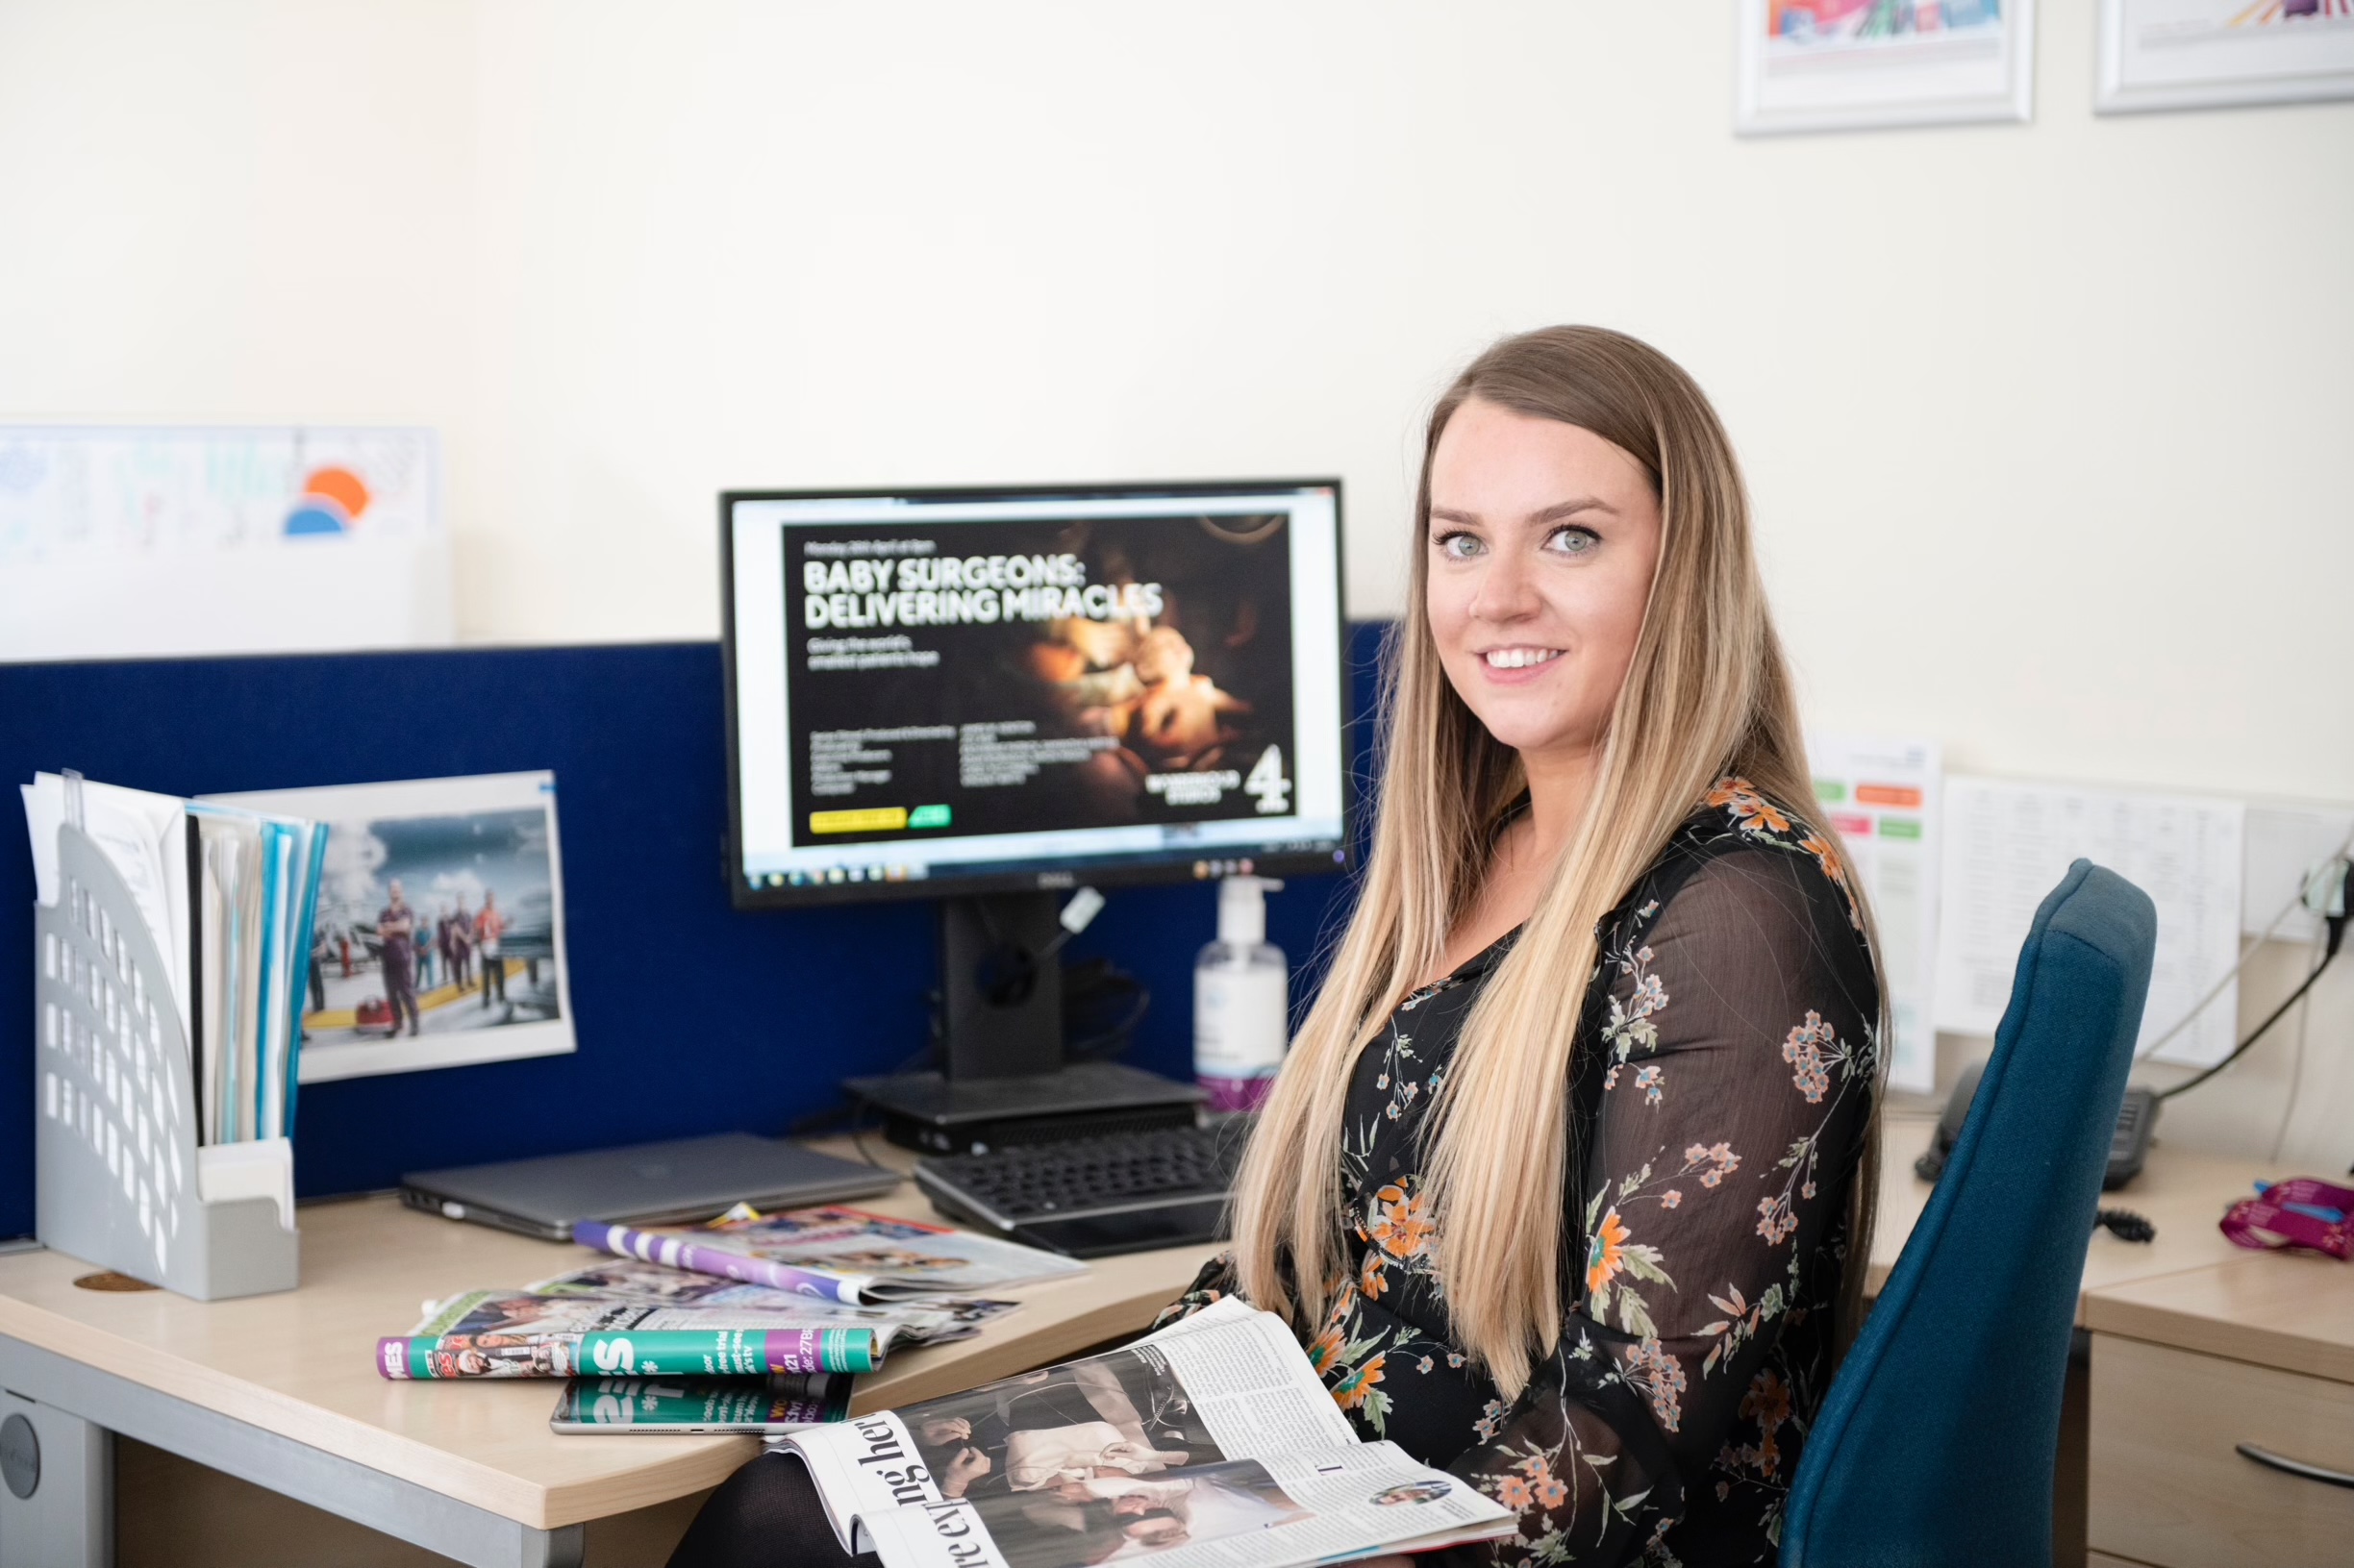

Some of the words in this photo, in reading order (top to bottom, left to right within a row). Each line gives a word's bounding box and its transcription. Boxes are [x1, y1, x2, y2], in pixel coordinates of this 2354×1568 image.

[804, 559, 895, 594] BABY
[897, 554, 1087, 591] SURGEONS:
[805, 588, 1000, 630] DELIVERING
[1002, 583, 1164, 623] MIRACLES
[1244, 744, 1291, 813] 4
[855, 1420, 906, 1467] her
